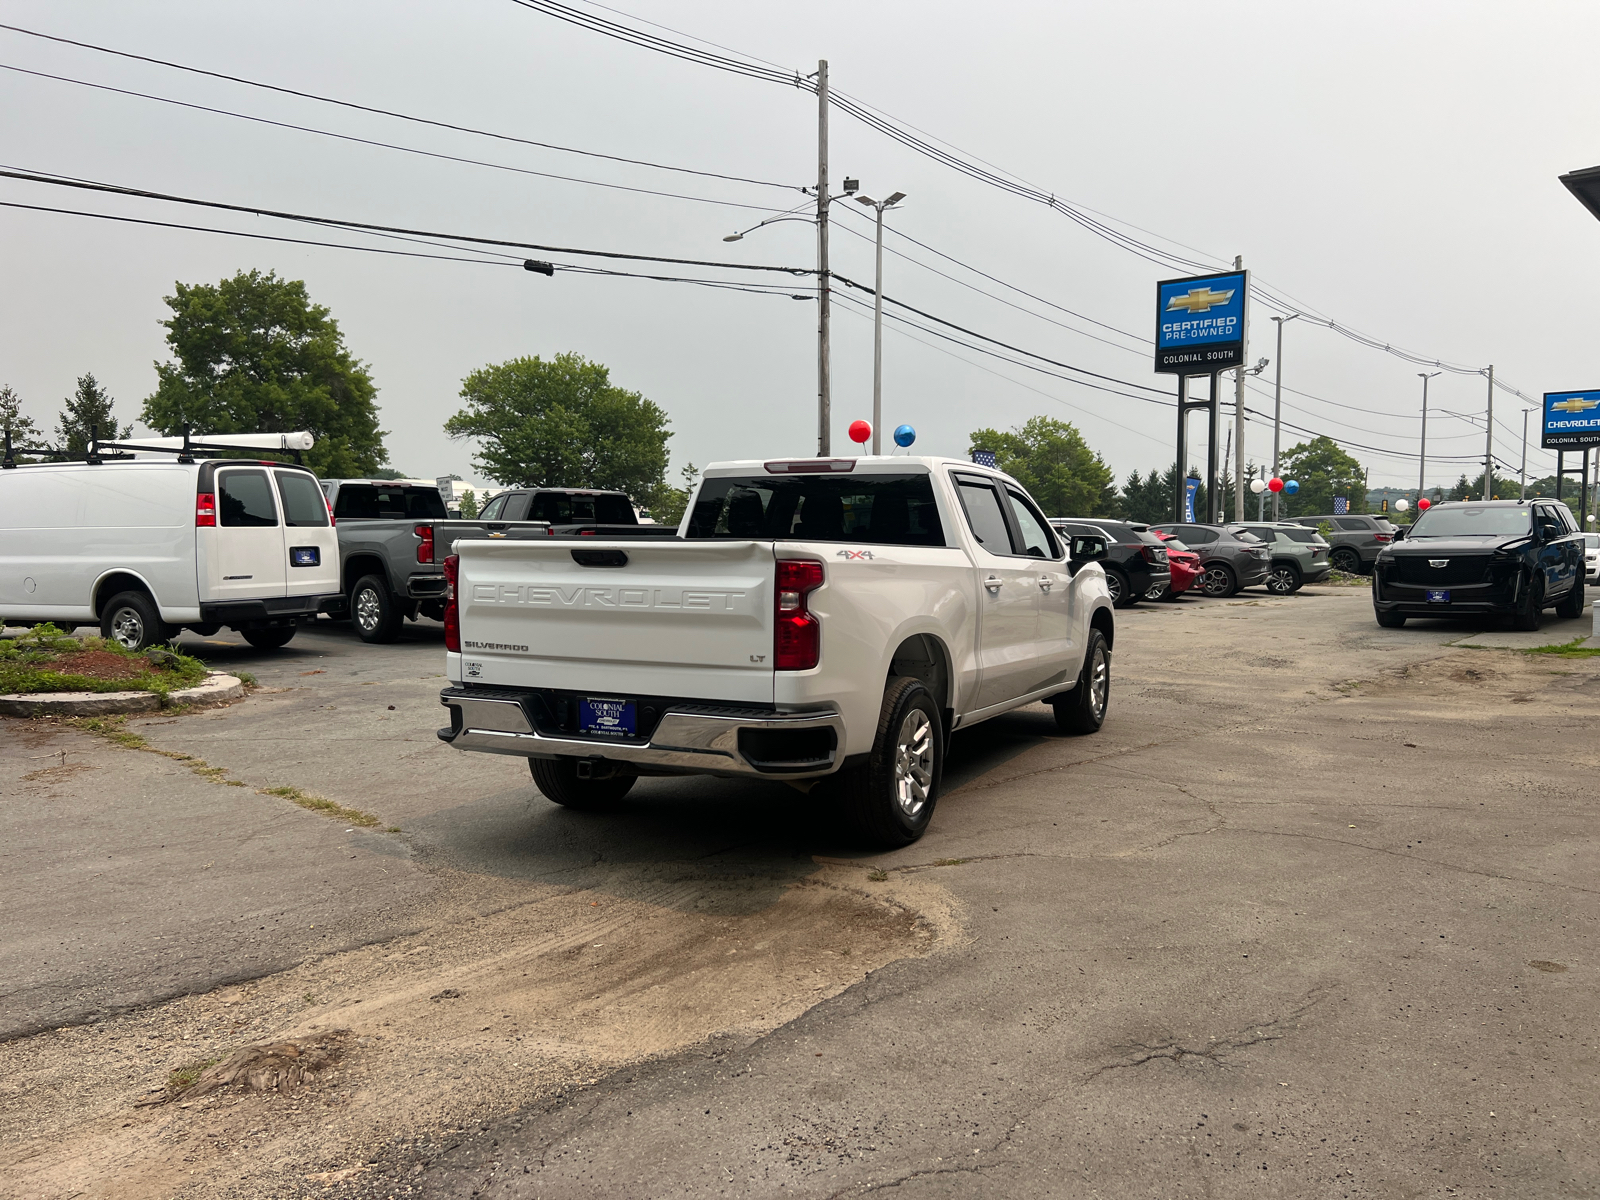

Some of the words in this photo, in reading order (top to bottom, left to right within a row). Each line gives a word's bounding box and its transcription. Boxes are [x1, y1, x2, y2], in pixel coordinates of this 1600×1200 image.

[1162, 316, 1237, 333] CERTIFIED
[1165, 326, 1233, 340] PRE-OWNED
[1163, 354, 1203, 364] COLONIAL
[1207, 350, 1234, 360] SOUTH
[472, 583, 746, 610] CHEVROLET
[464, 640, 529, 652] SILVERADO
[749, 654, 766, 663] LT
[590, 702, 624, 711] COLONIAL
